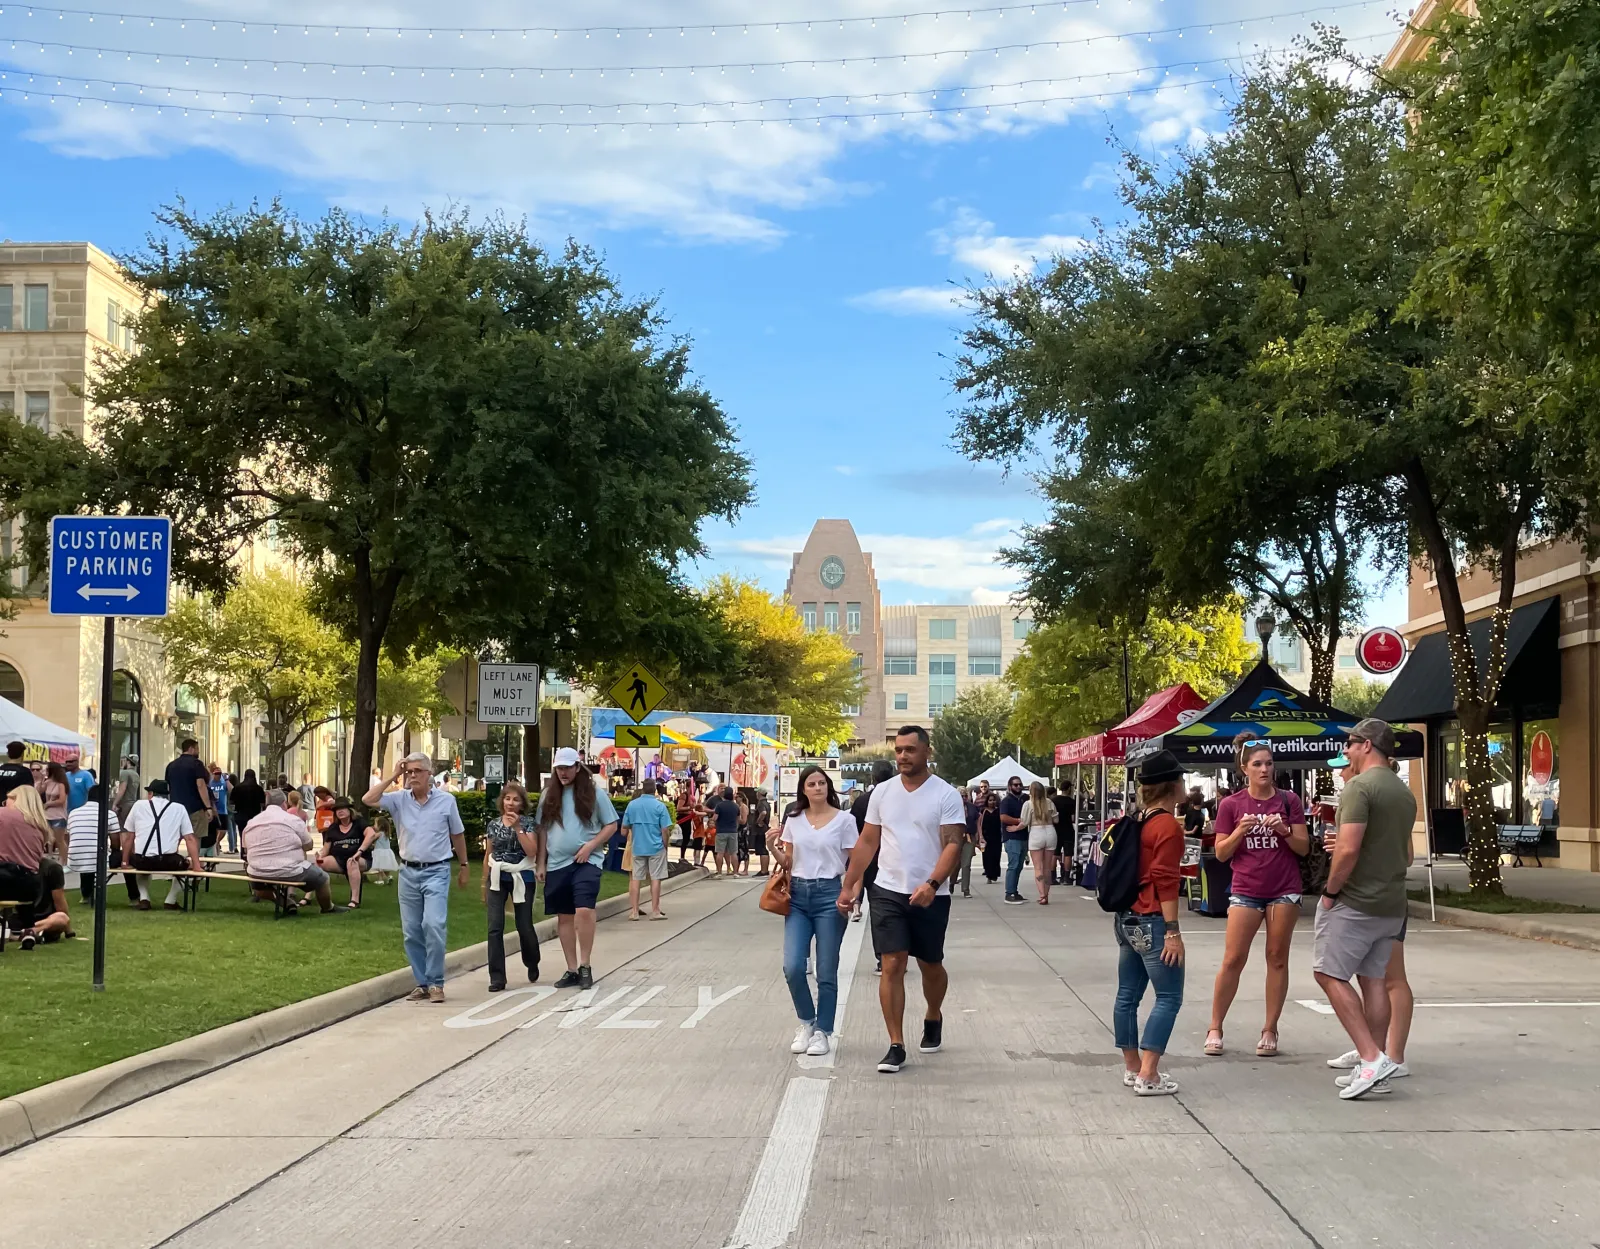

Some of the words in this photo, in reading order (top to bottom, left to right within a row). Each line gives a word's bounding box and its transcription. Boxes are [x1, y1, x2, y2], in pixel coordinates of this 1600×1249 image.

[59, 531, 162, 550] CUSTOMER
[67, 557, 152, 576] PARKING
[1372, 660, 1392, 668] TORO
[484, 671, 505, 681] LEFT
[510, 672, 532, 682] LANE
[493, 688, 523, 700] MUST
[484, 706, 506, 715] TURN
[510, 706, 532, 716] LEFT
[1246, 836, 1279, 850] BEER
[443, 986, 750, 1029] ONLY
